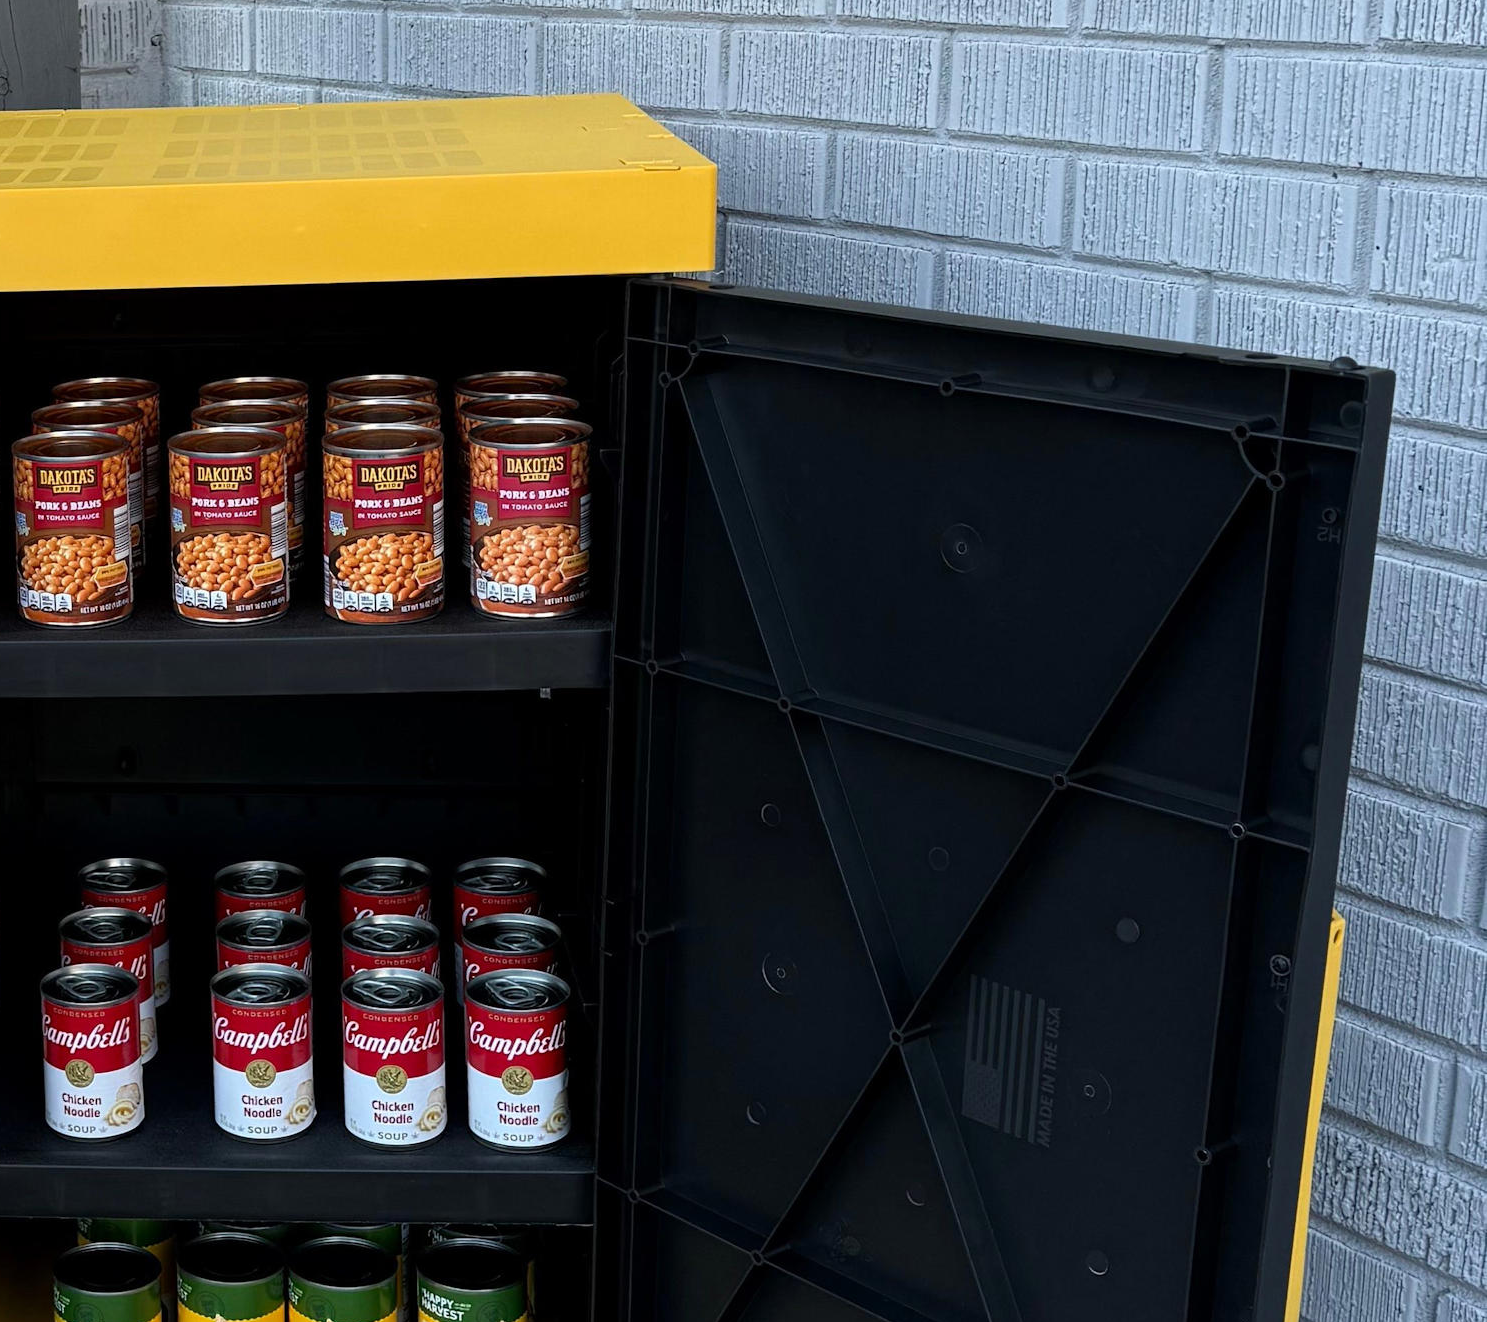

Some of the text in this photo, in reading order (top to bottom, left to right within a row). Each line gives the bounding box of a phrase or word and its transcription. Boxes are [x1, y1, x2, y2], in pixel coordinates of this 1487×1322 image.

[506, 456, 564, 474] DAKOTA'S
[40, 469, 95, 485] DAKOTA'S
[197, 466, 253, 481] DAKOTA'S
[361, 465, 417, 482] DAKOTA'S
[377, 482, 402, 490] PRIDE
[500, 490, 527, 499] PORK
[538, 488, 570, 499] BEANS
[35, 501, 60, 510] PORK
[70, 501, 102, 510] BEANS
[192, 498, 217, 507] PORK
[227, 497, 259, 507] BEANS
[355, 499, 382, 509] PORK
[393, 496, 423, 507] BEANS
[46, 514, 75, 522] TOMATO
[77, 513, 100, 521] SAUCE
[234, 510, 257, 518] SAUCE
[399, 510, 421, 518] SAUCE
[53, 1008, 105, 1018] CONDENSED
[232, 1009, 287, 1018] CONDENSED
[363, 1013, 419, 1022] CONDENSED
[489, 1014, 546, 1022] CONDENSED
[42, 1015, 131, 1053] Campbell's
[214, 1012, 308, 1054] Campbell's
[345, 1017, 440, 1060] Campbell's
[469, 1016, 566, 1061] Campbell's
[1037, 1007, 1062, 1148] MADE IN THE USA
[62, 1093, 102, 1106] Chicken
[242, 1095, 283, 1106] Chicken
[64, 1105, 101, 1118] Noodle
[372, 1101, 414, 1111] Chicken
[497, 1101, 540, 1113] Chicken
[244, 1107, 282, 1118] Noodle
[374, 1113, 413, 1124] Noodle
[499, 1114, 539, 1125] Noodle
[67, 1124, 96, 1133] SOUP
[248, 1126, 278, 1134] SOUP
[378, 1132, 408, 1140] SOUP
[503, 1133, 534, 1142] SOUP
[422, 1289, 455, 1309] HAPPY
[422, 1298, 464, 1322] HARVEST
